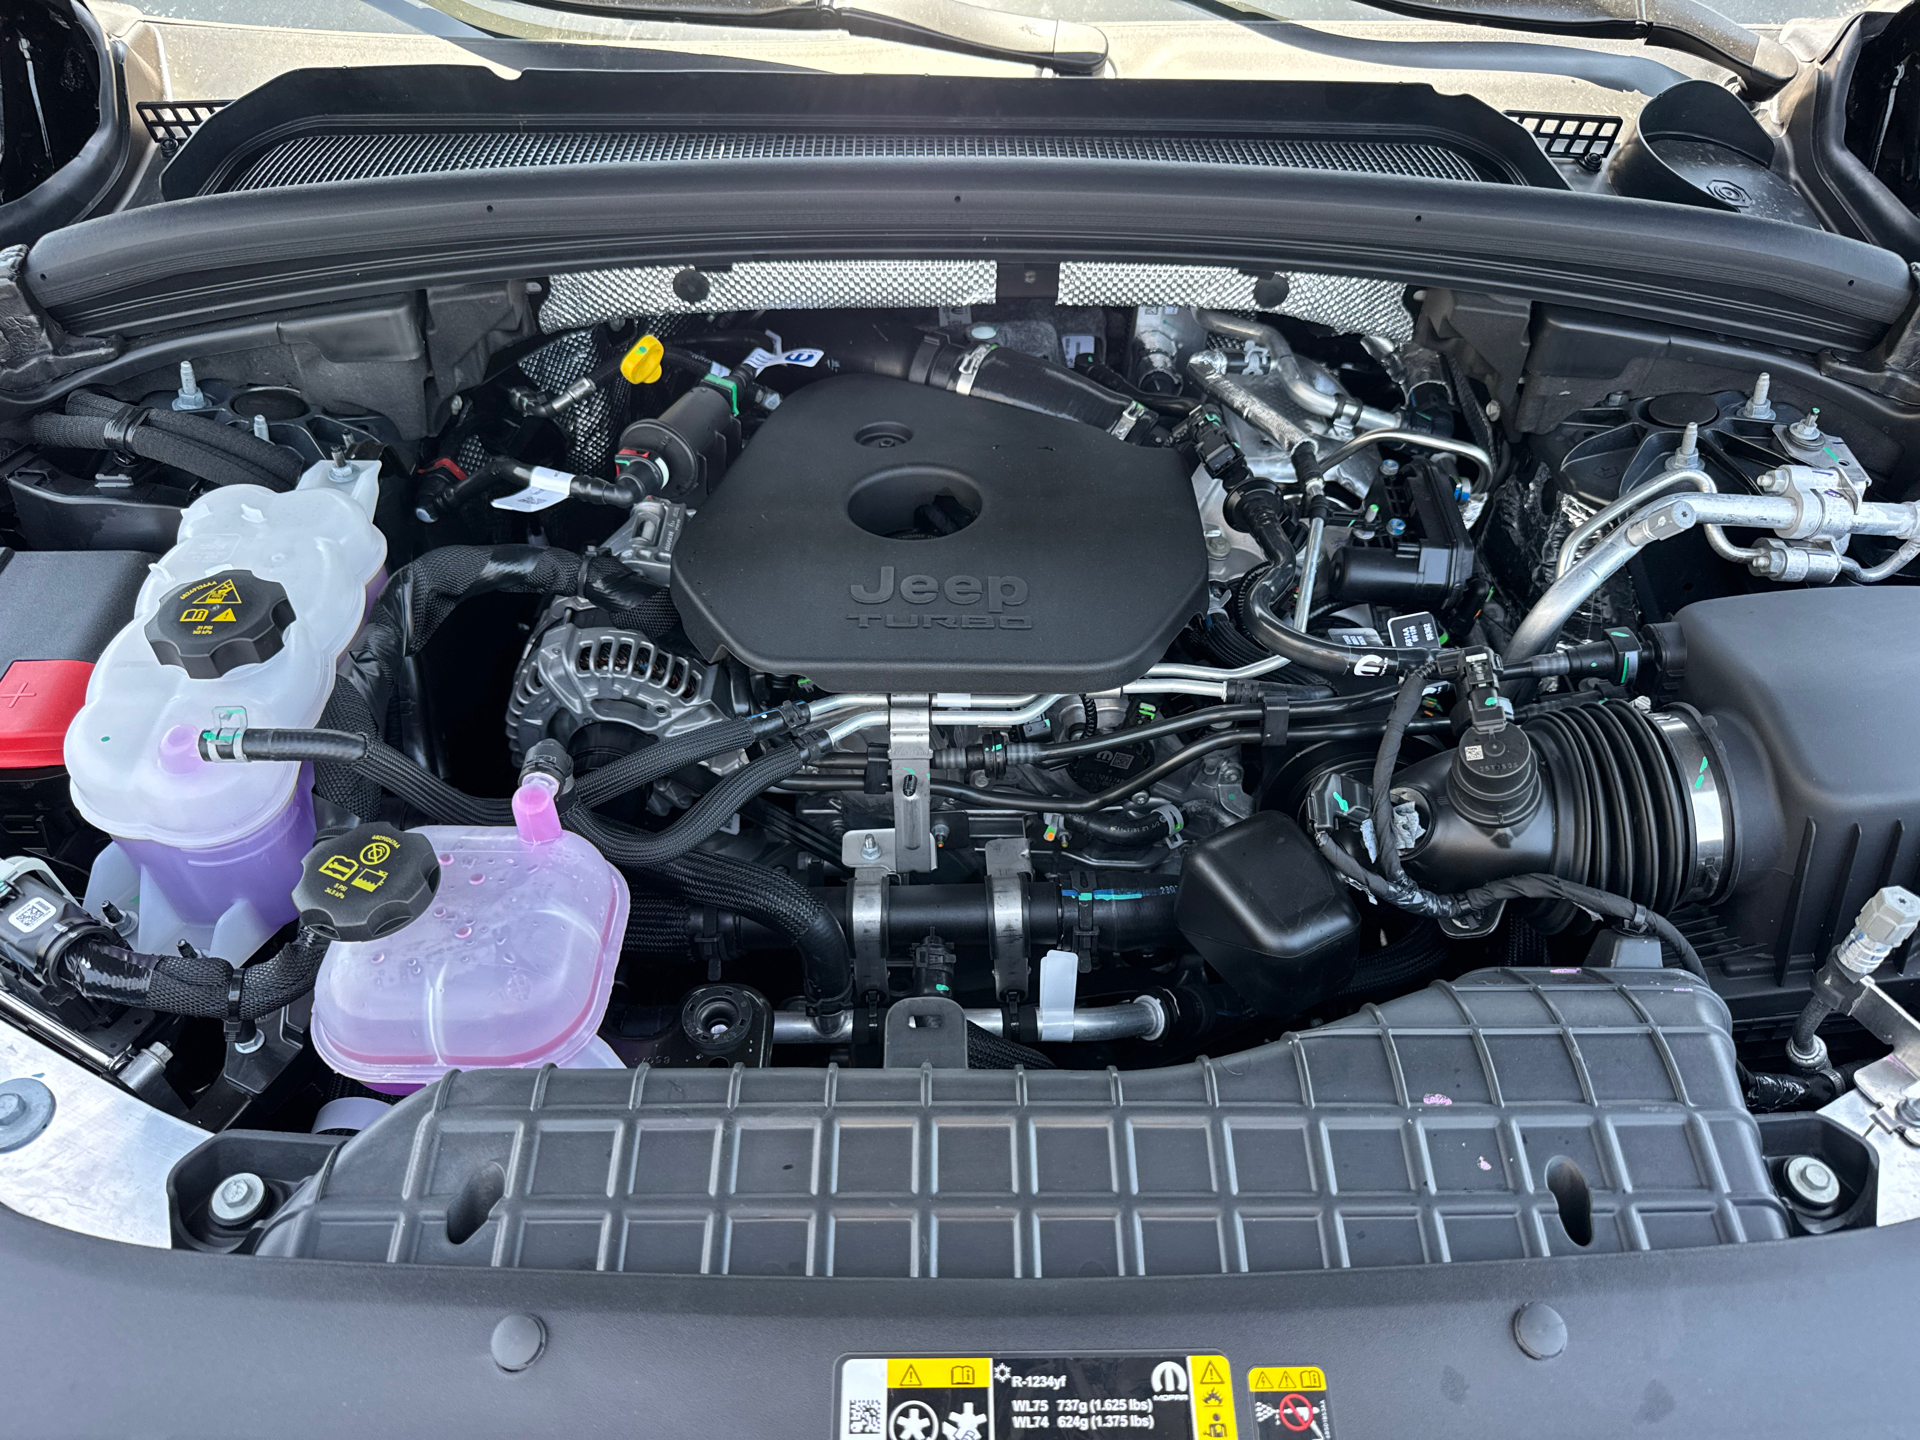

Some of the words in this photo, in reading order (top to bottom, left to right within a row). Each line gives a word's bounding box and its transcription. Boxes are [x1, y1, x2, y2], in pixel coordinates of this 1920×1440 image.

[850, 566, 1029, 613] Jeep
[846, 614, 1033, 630] TURBO
[338, 884, 348, 892] PSI
[1011, 1375, 1067, 1390] R-1234yf
[1011, 1400, 1049, 1412] WL75
[1057, 1400, 1088, 1414] 737g
[1089, 1399, 1127, 1413] (1.625
[1129, 1399, 1153, 1413] lbs)
[1012, 1416, 1050, 1428] WL74
[1057, 1416, 1089, 1430] 624g
[1090, 1415, 1128, 1430] (1.375
[1130, 1415, 1154, 1430] lbs)
